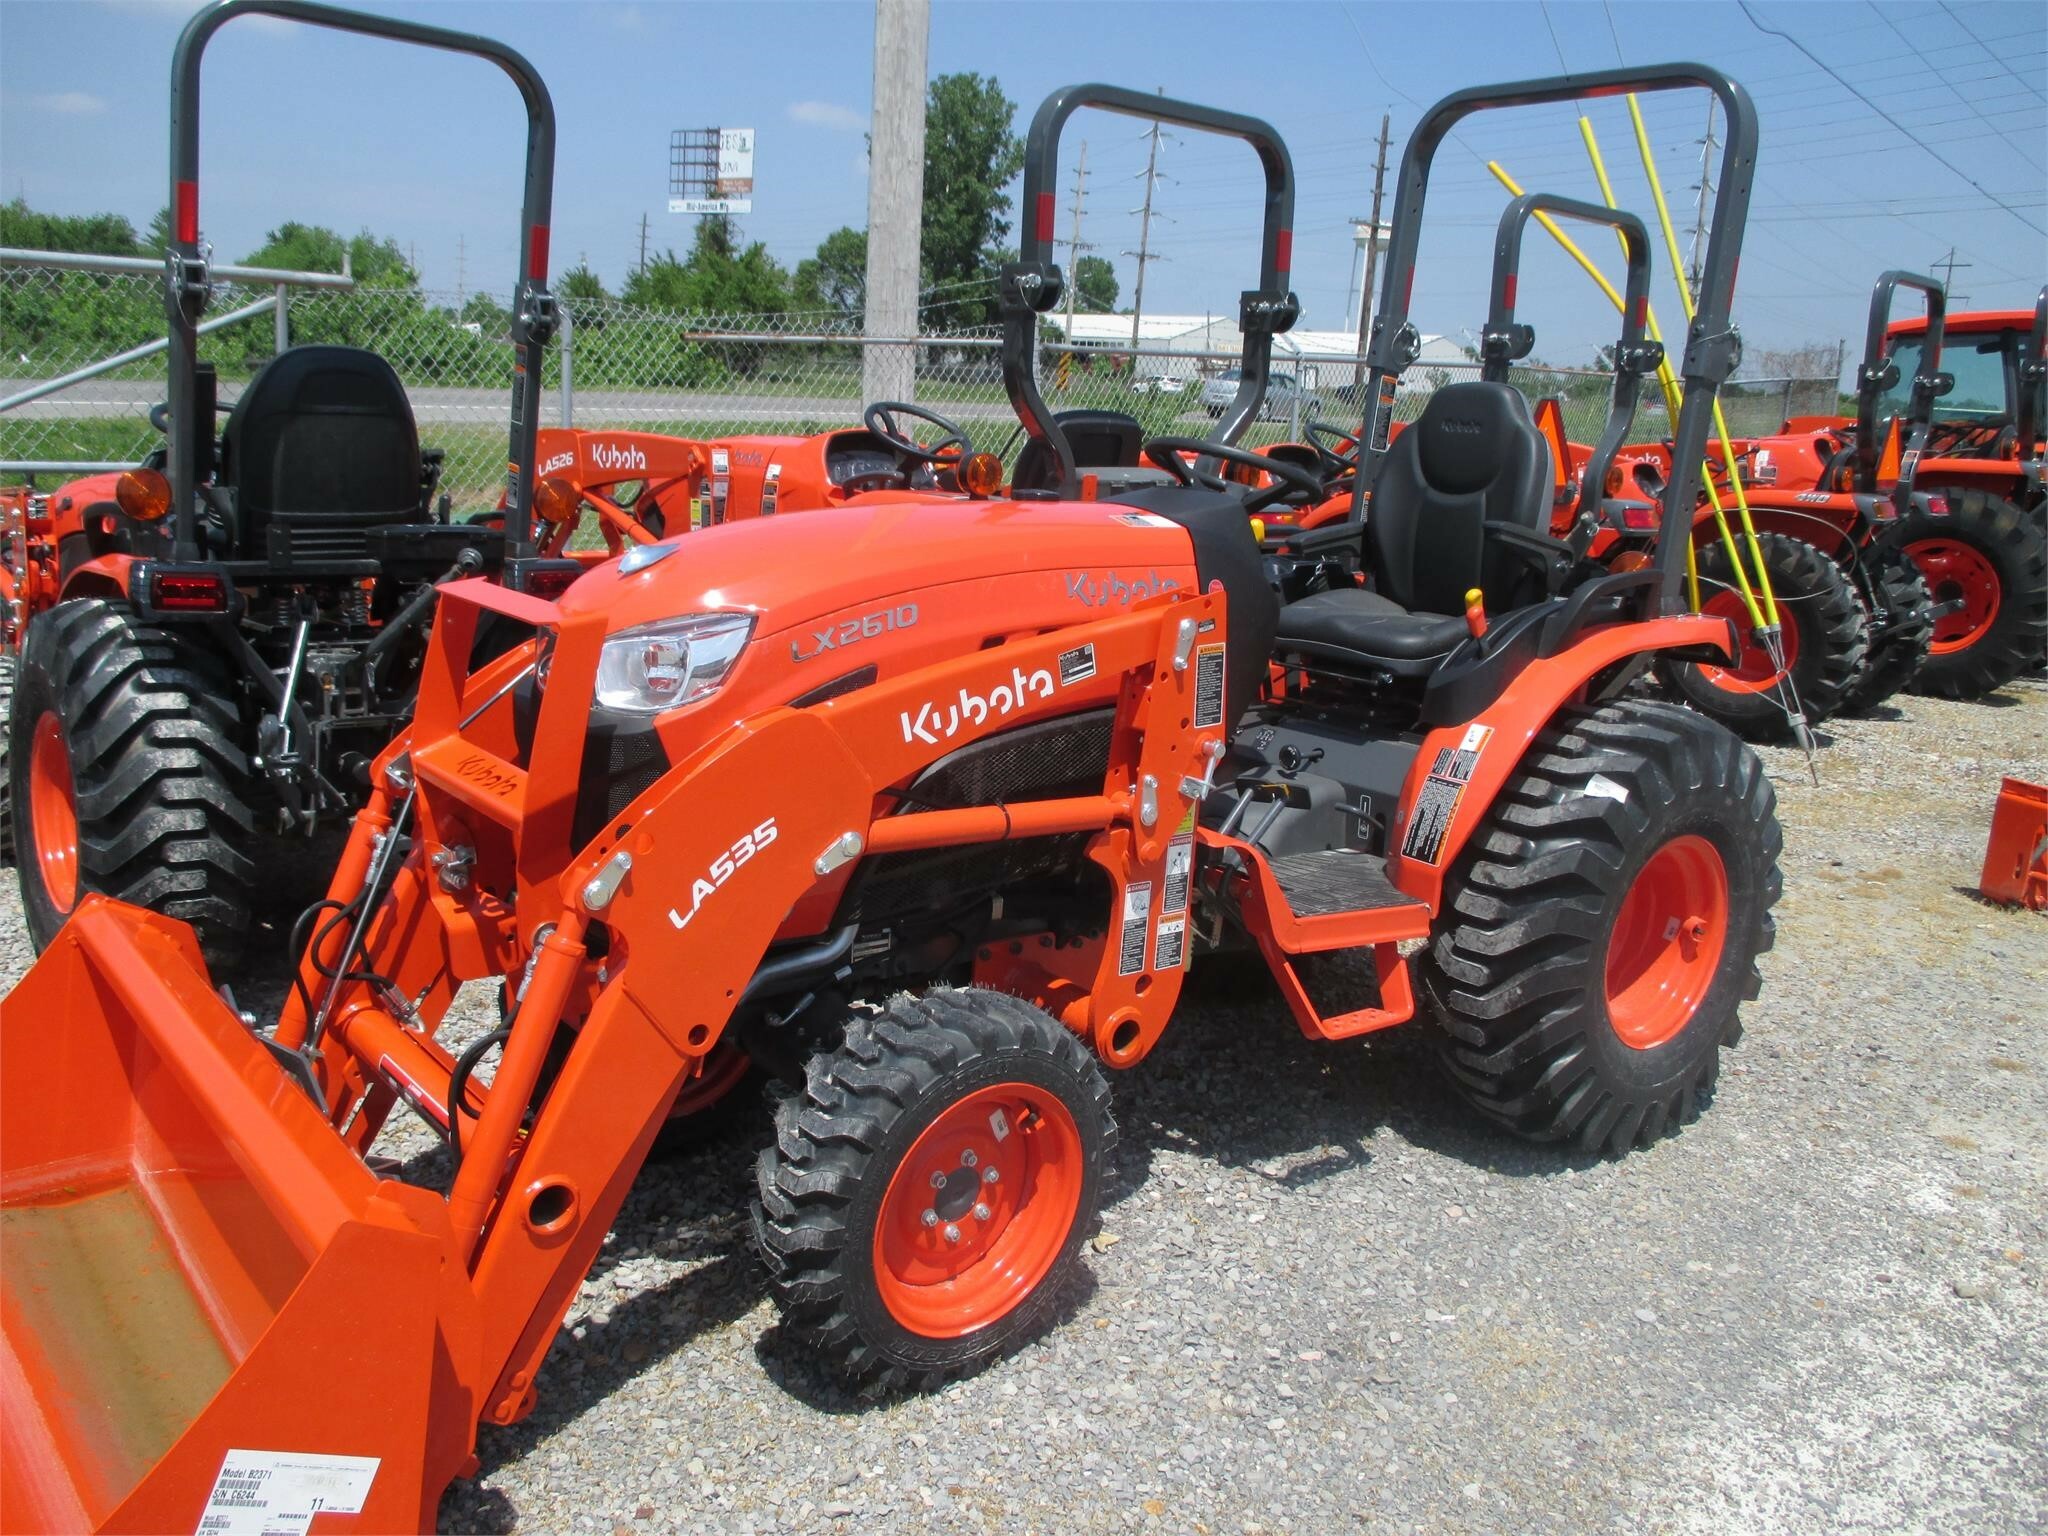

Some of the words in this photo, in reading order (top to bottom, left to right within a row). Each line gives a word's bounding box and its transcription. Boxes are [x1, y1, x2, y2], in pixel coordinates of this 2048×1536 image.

[538, 451, 574, 477] LA526
[592, 443, 646, 470] Kubota
[1065, 571, 1180, 607] Kubota
[790, 603, 918, 663] LX2610
[900, 667, 1054, 745] Kubota
[456, 755, 519, 797] Kubota
[668, 816, 779, 930] LA535
[221, 1468, 246, 1479] Model
[248, 1470, 273, 1480] B2371
[212, 1489, 227, 1499] S/N
[231, 1490, 256, 1500] C6244
